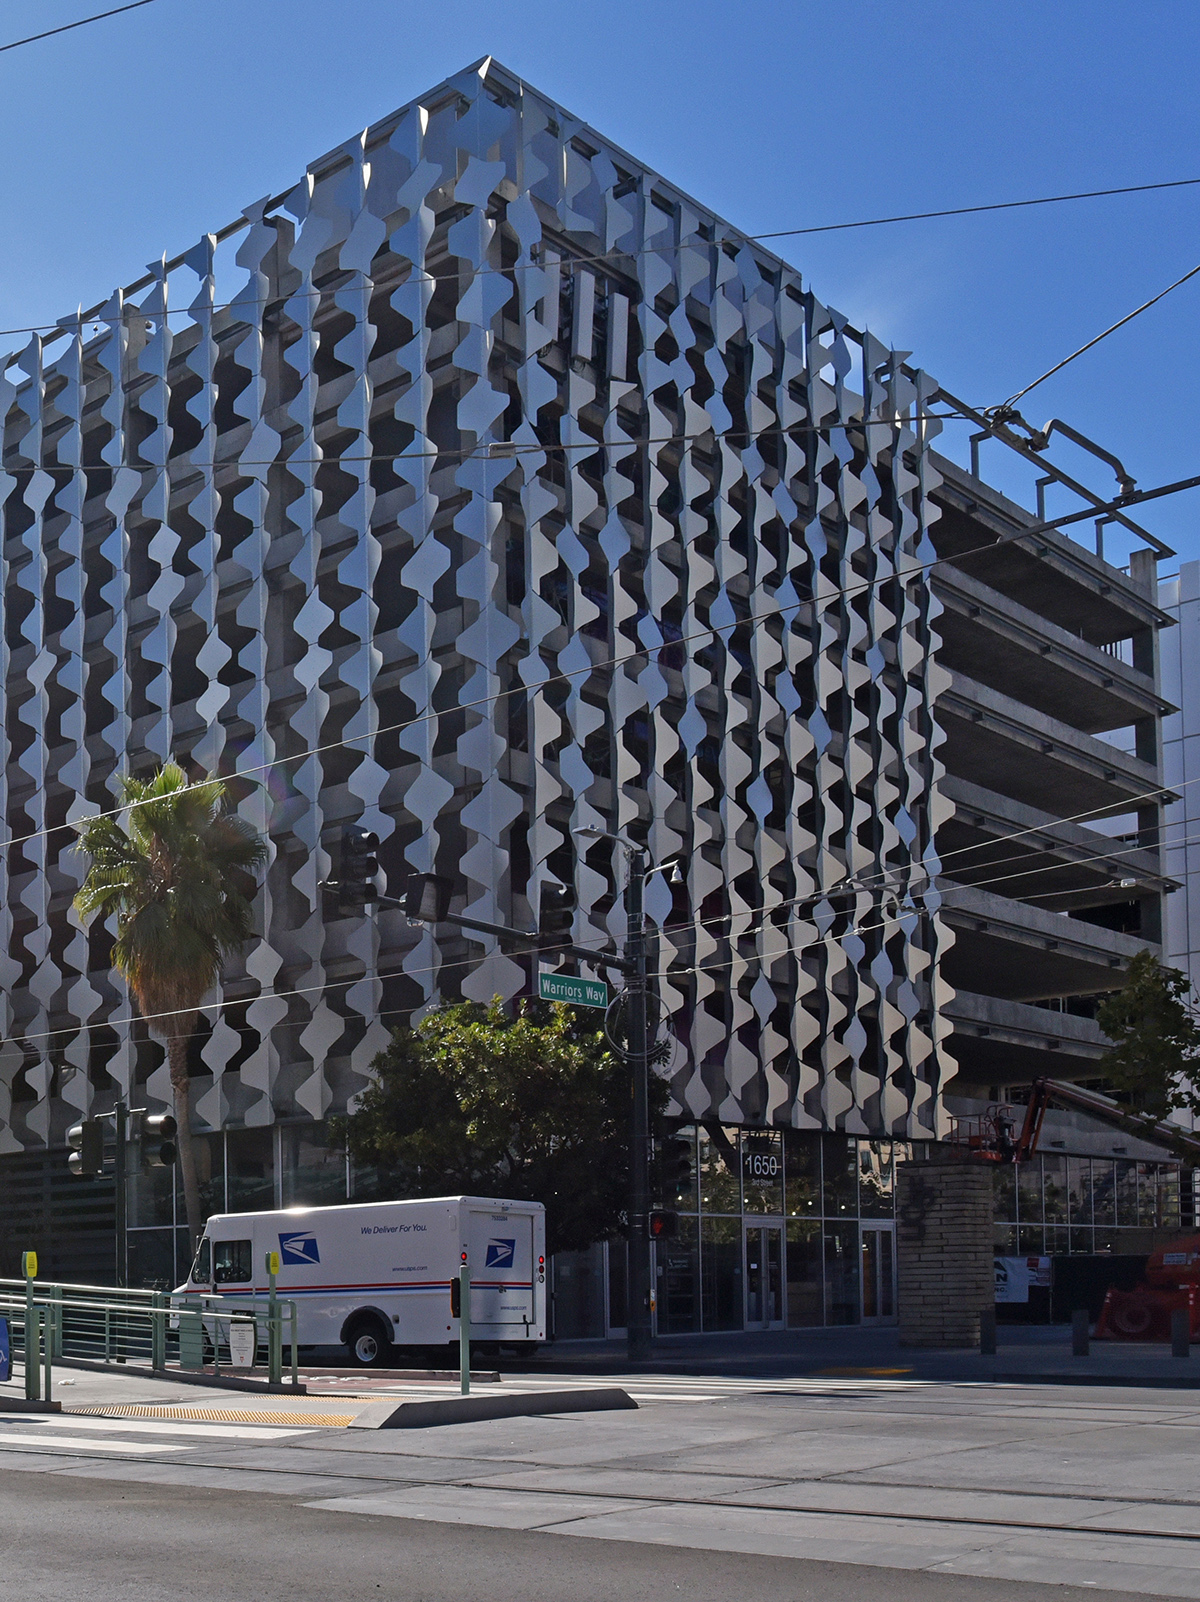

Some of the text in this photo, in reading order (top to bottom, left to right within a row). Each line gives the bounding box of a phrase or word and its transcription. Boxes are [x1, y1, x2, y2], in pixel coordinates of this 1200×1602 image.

[542, 979, 582, 998] Warriors
[586, 986, 604, 1004] Way
[746, 1155, 777, 1175] 1650
[373, 1226, 398, 1234] Deliver
